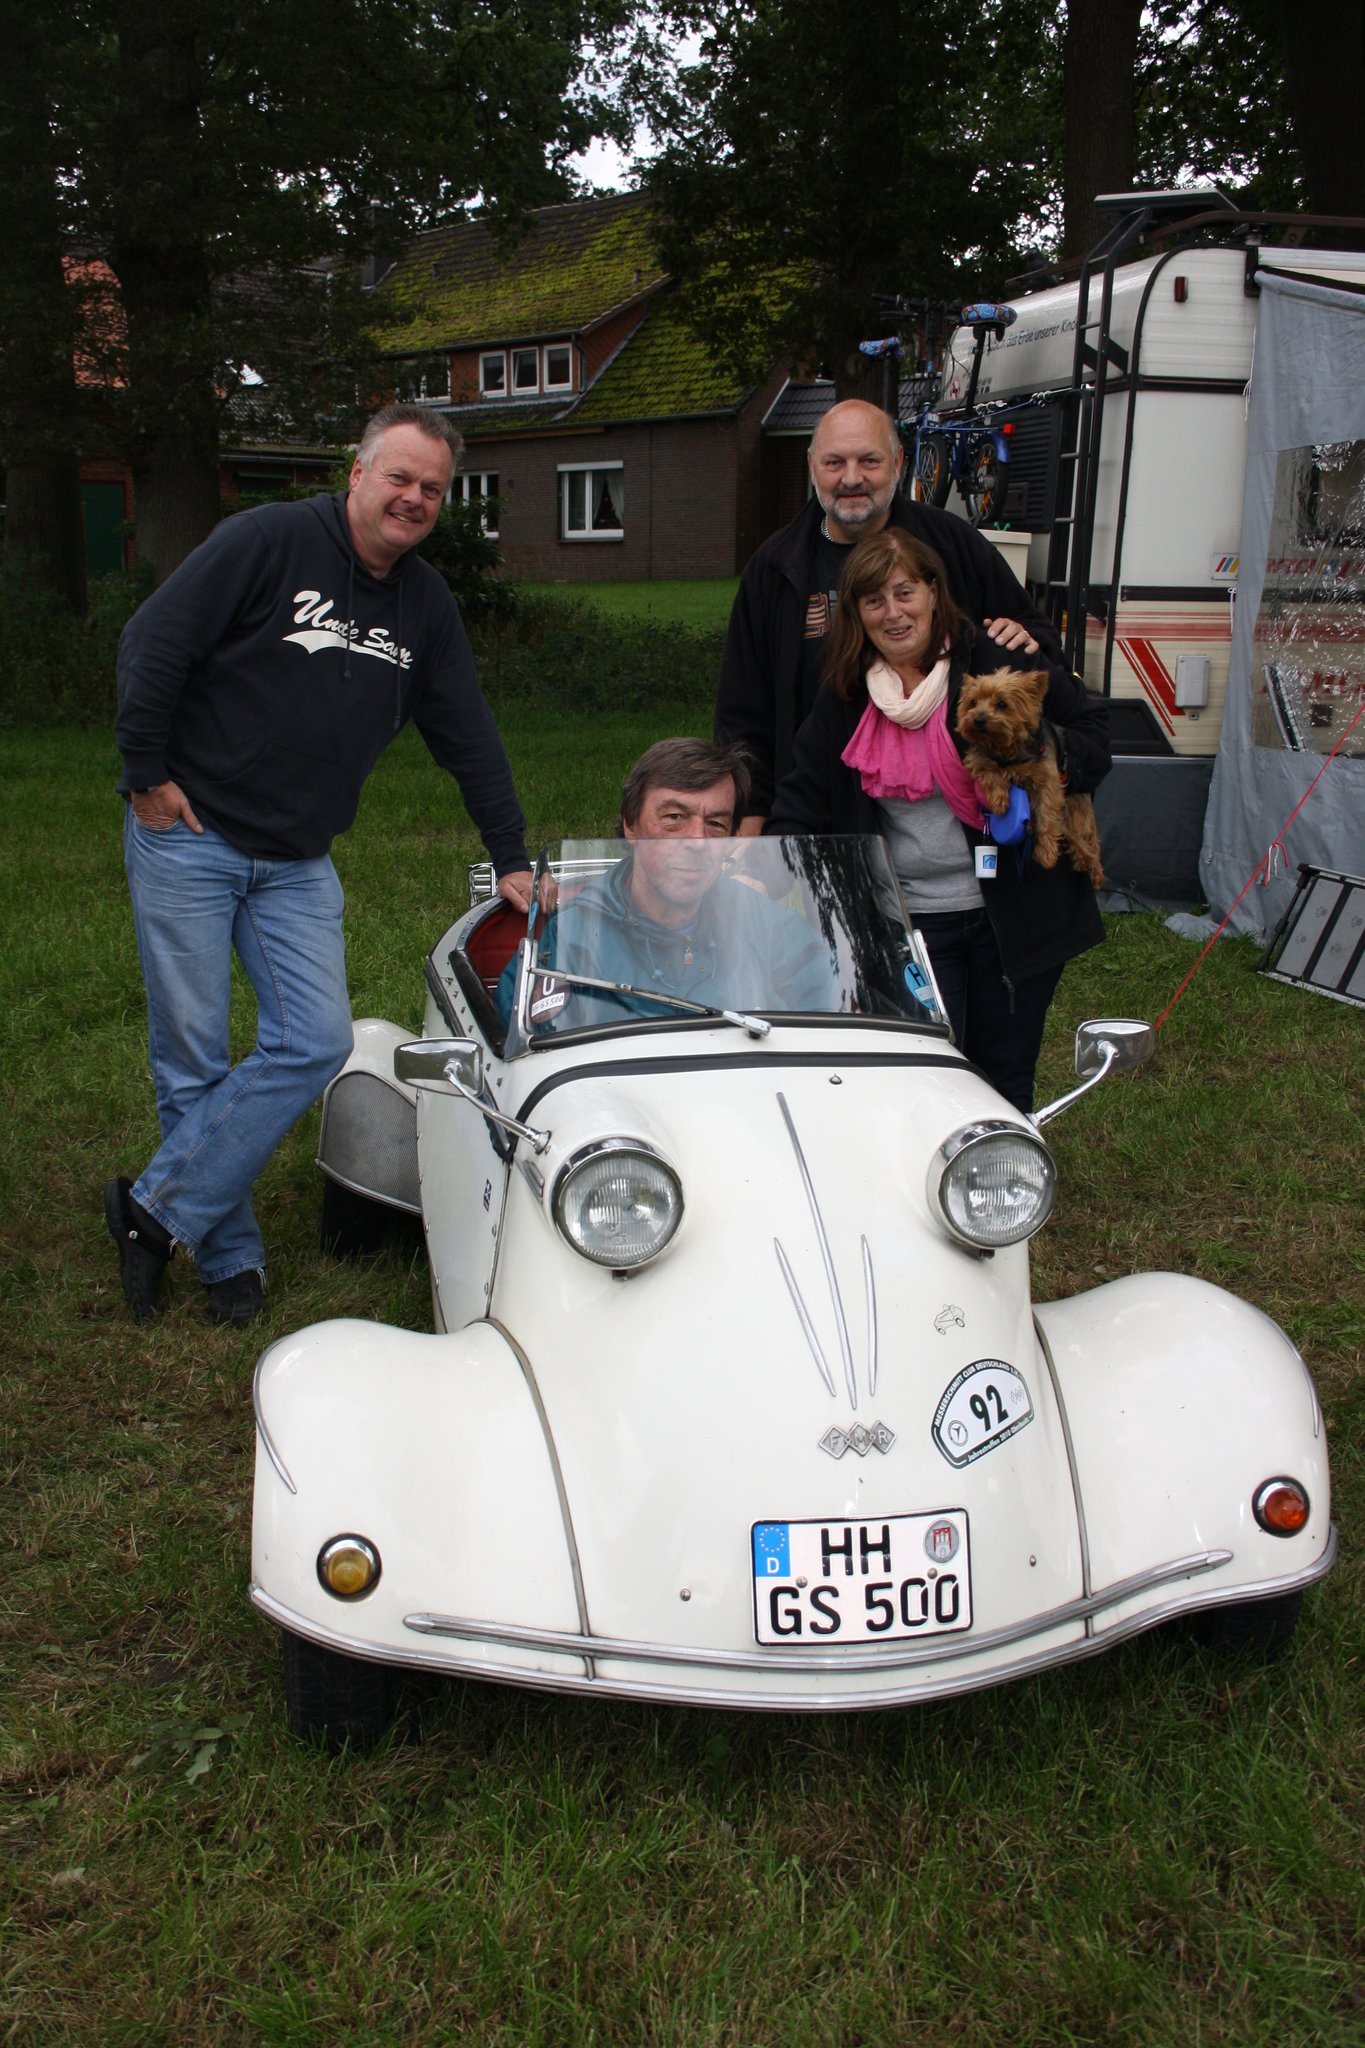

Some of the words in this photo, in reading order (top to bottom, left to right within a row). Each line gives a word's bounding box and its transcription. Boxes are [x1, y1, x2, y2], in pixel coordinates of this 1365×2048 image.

[363, 627, 414, 664] Sam
[906, 963, 926, 987] H
[934, 1374, 964, 1427] MESSERSCHMITT
[962, 1365, 976, 1378] CLUB
[974, 1360, 1009, 1370] DEUTSCHLAND
[968, 1384, 1009, 1432] 92
[766, 1556, 780, 1575] D
[820, 1524, 892, 1577] HH
[769, 1584, 842, 1636] GS
[864, 1573, 959, 1632] 500
